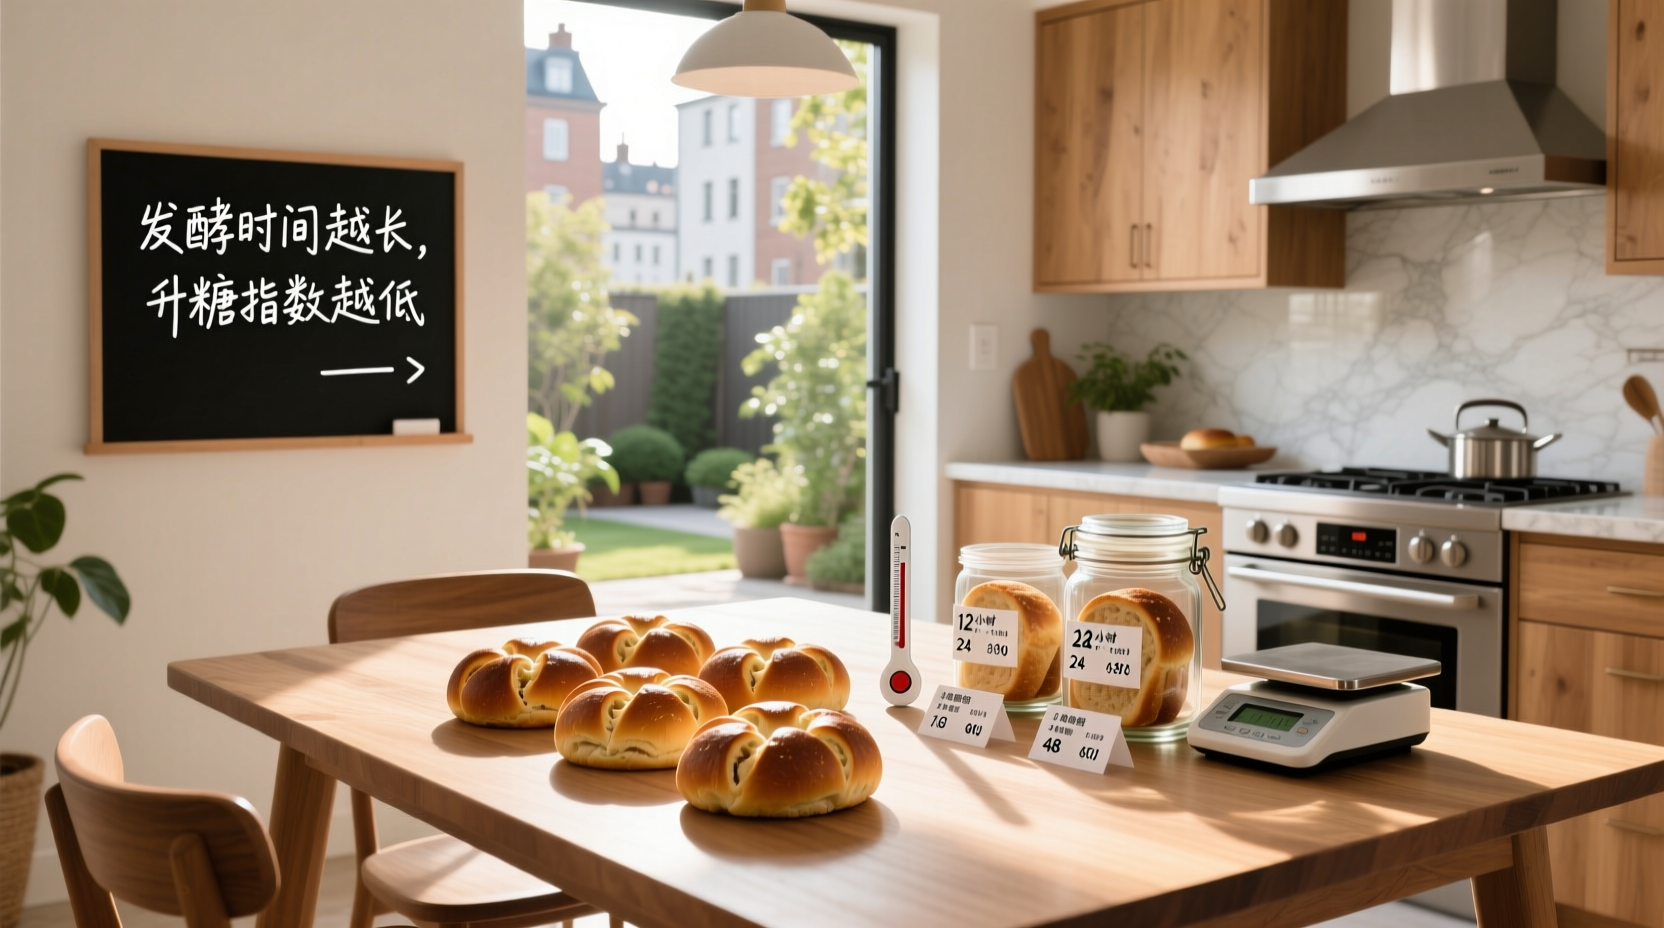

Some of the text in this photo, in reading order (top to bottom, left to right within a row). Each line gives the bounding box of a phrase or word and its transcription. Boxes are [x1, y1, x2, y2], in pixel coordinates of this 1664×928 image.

[140, 197, 427, 260] 发酵时间越长，
[146, 273, 425, 339] 升糖指数越低
[956, 638, 972, 652] 24
[1069, 655, 1086, 670] 24
[1042, 737, 1062, 753] 48
